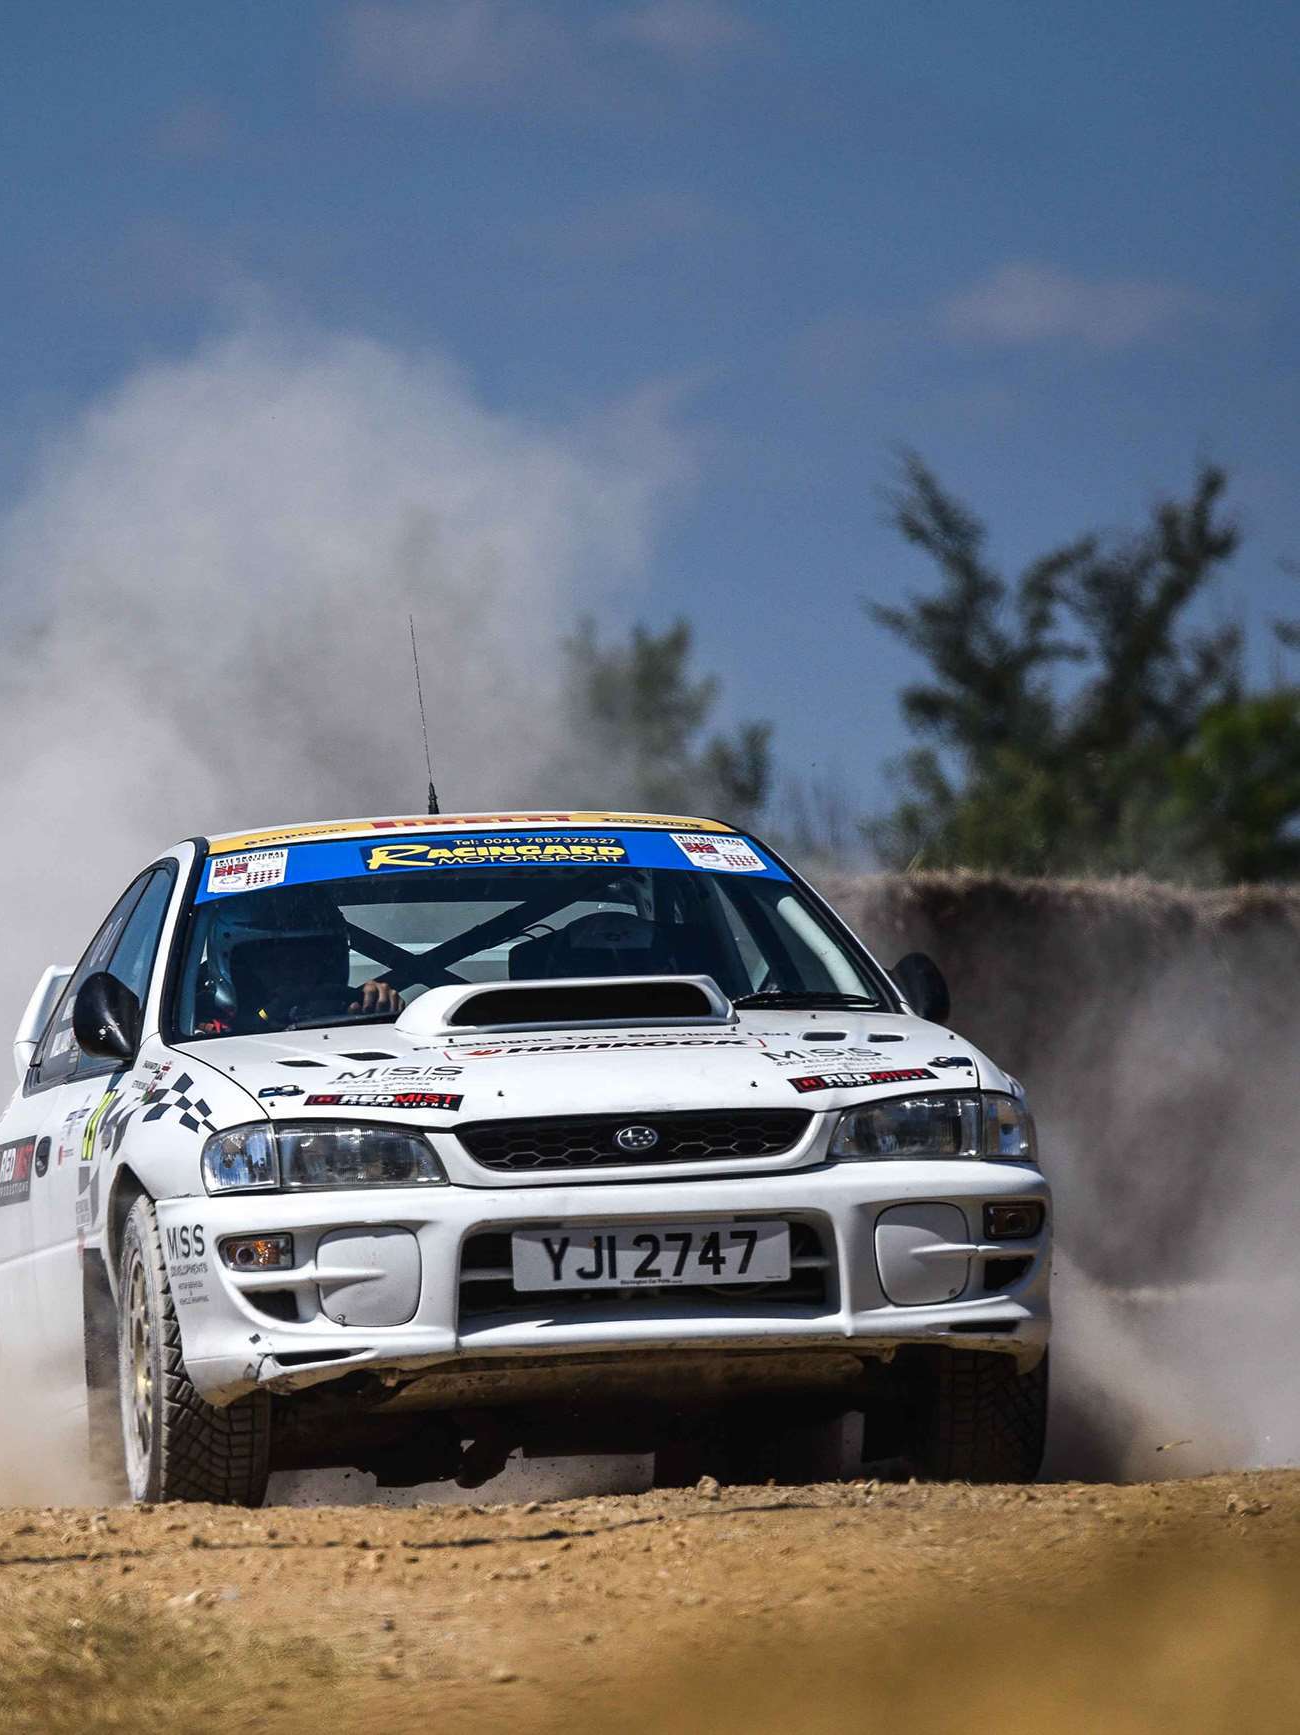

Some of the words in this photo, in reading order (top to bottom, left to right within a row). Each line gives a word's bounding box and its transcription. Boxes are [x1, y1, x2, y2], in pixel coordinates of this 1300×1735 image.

[453, 838, 479, 846] Tel:
[484, 837, 520, 845] 0044
[527, 837, 616, 845] 7887372527
[367, 844, 625, 870] RACINGARD
[438, 854, 623, 865] MOTORSPORT
[340, 1093, 458, 1104] REDMIST
[542, 1234, 617, 1281] YJI
[632, 1230, 758, 1279] 2747
